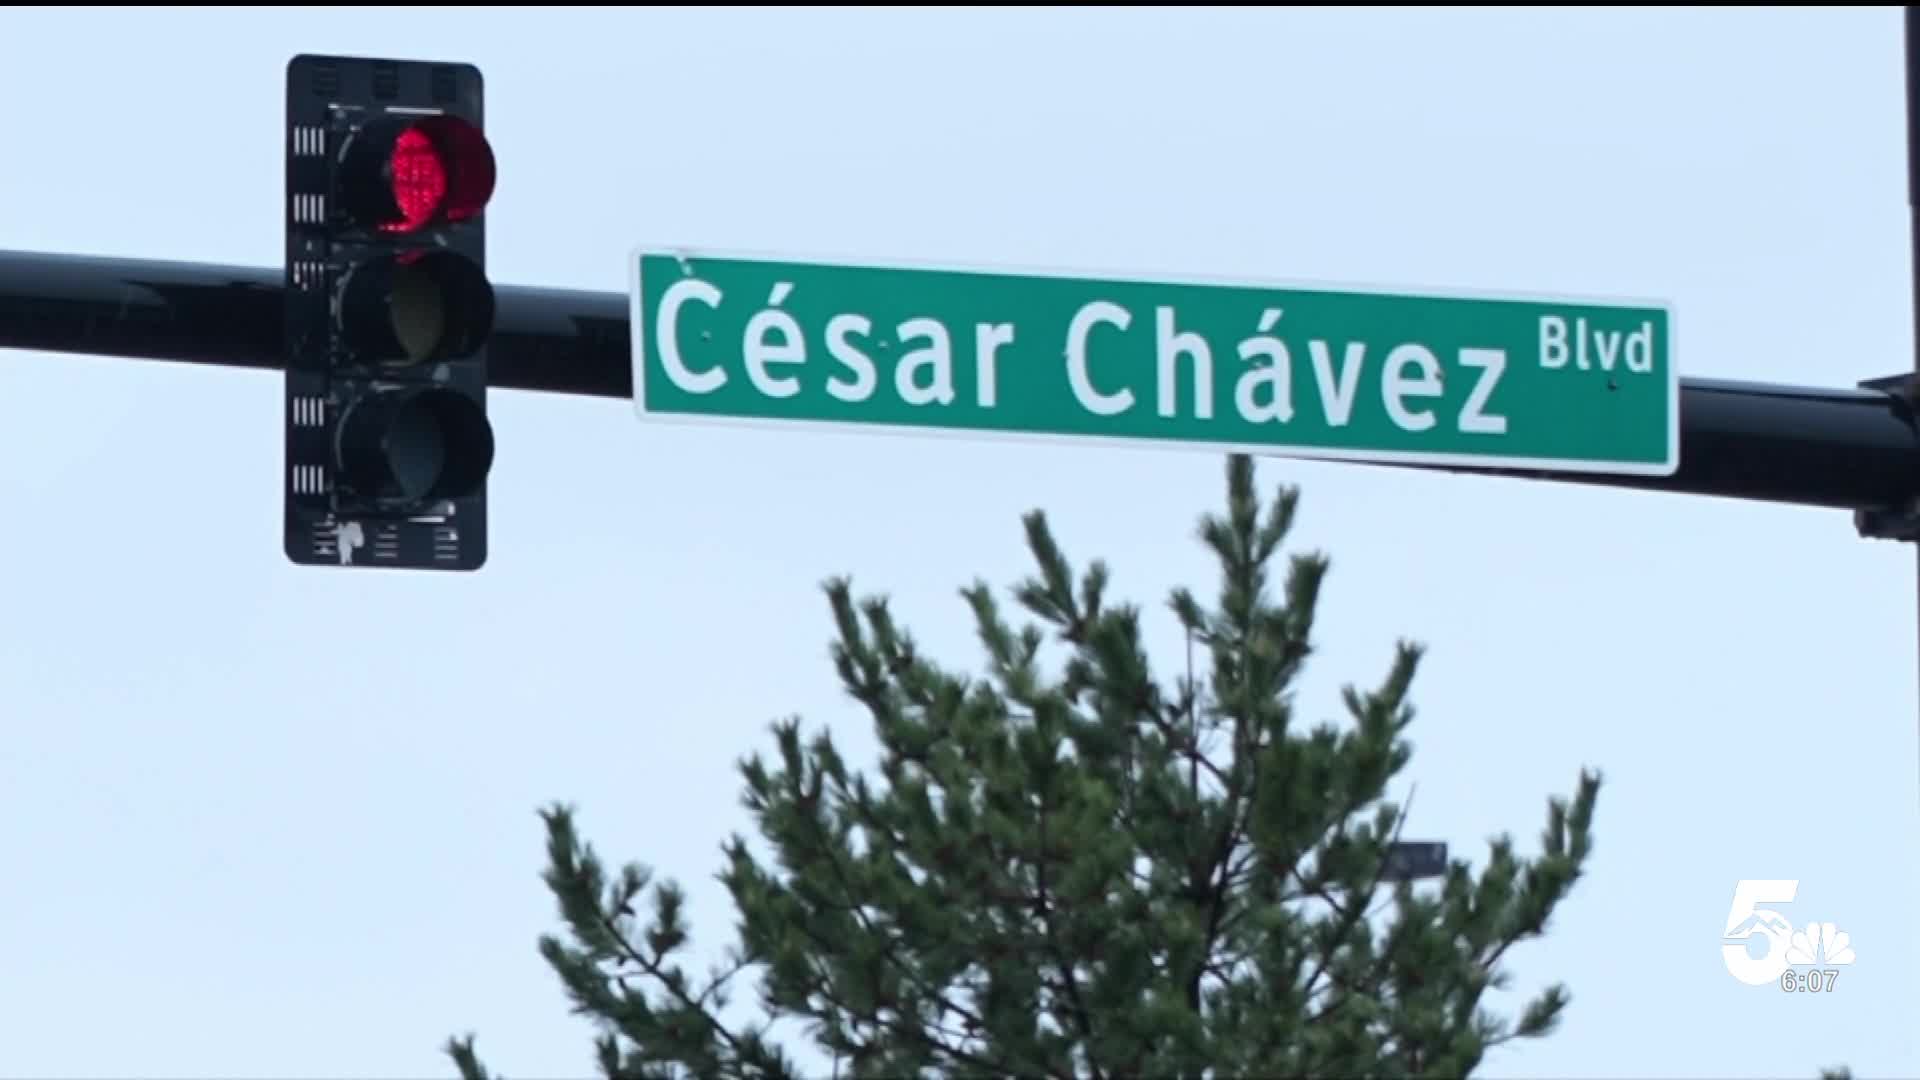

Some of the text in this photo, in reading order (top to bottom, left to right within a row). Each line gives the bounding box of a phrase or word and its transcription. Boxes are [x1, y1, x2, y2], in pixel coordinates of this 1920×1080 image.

[656, 279, 1653, 434] César Chávez Blvd
